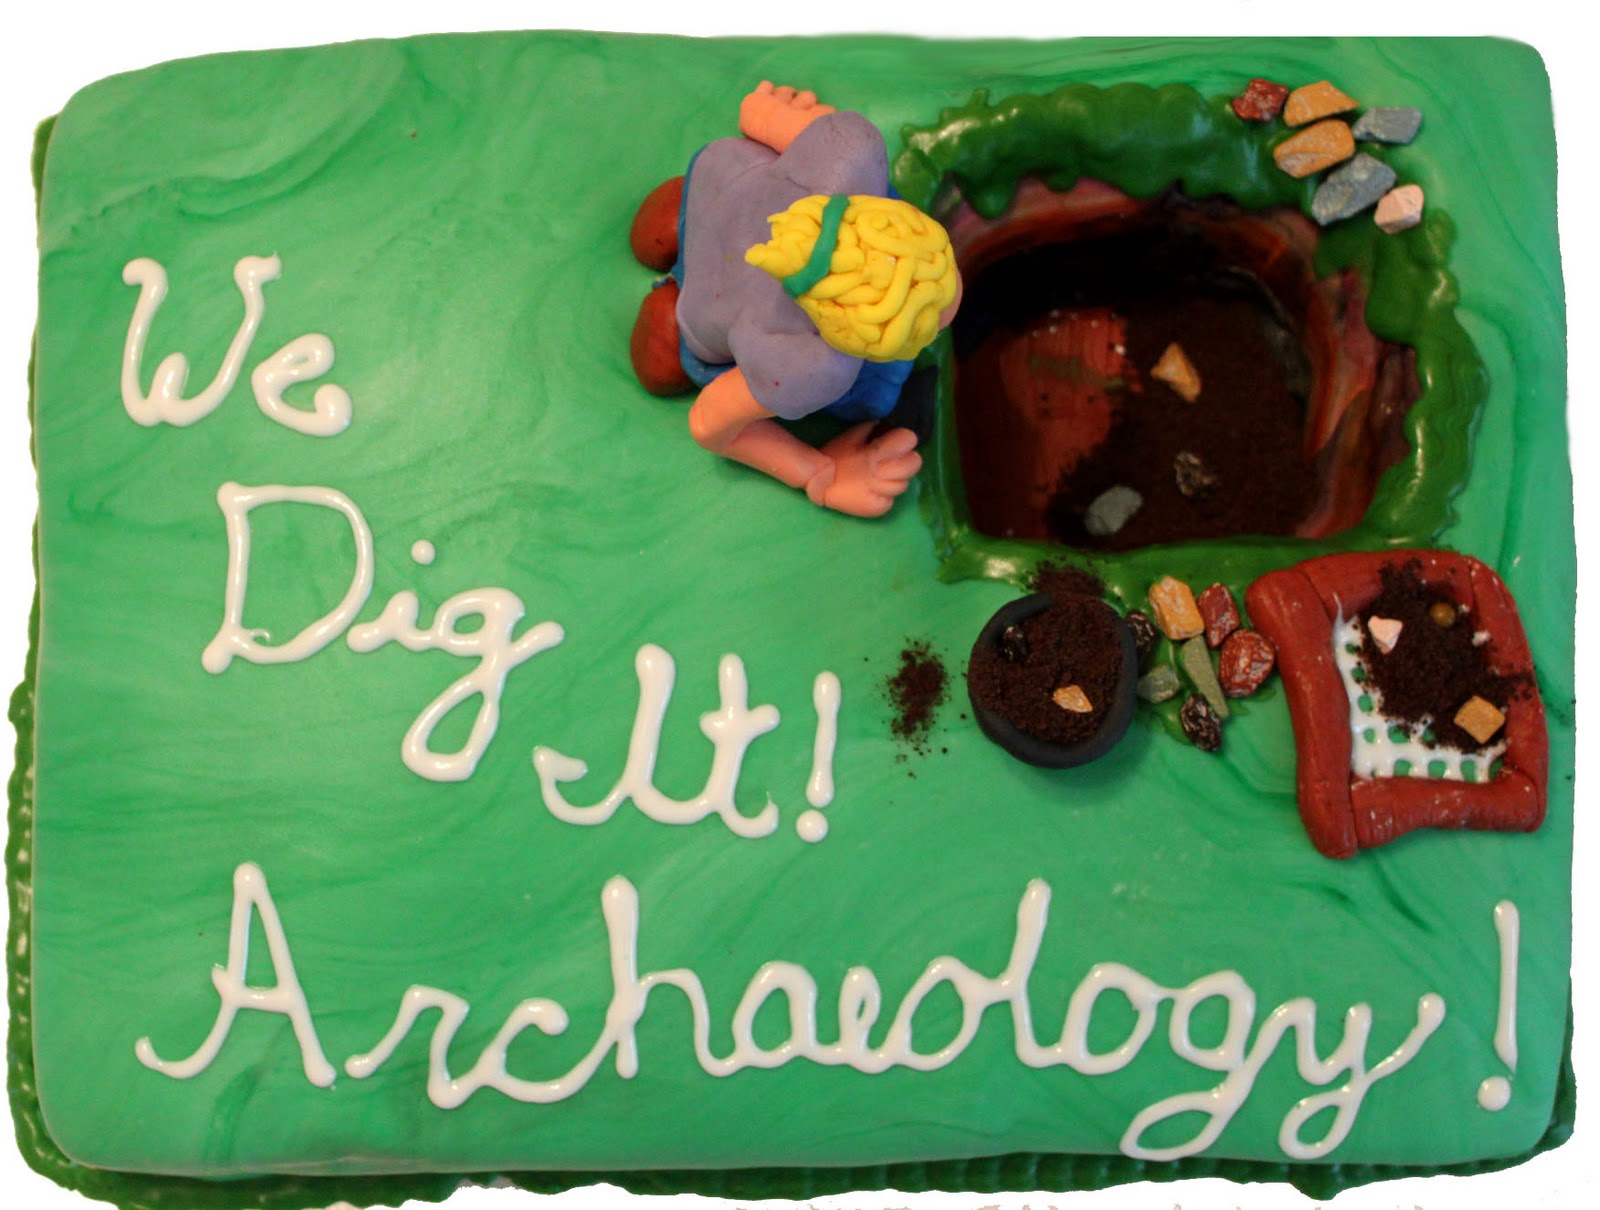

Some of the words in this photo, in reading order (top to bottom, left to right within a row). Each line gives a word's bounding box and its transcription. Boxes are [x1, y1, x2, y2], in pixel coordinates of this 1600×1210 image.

[121, 254, 353, 437] We
[201, 483, 564, 782] Dig
[534, 643, 841, 842] It!
[135, 862, 1521, 1162] Archaeology!
